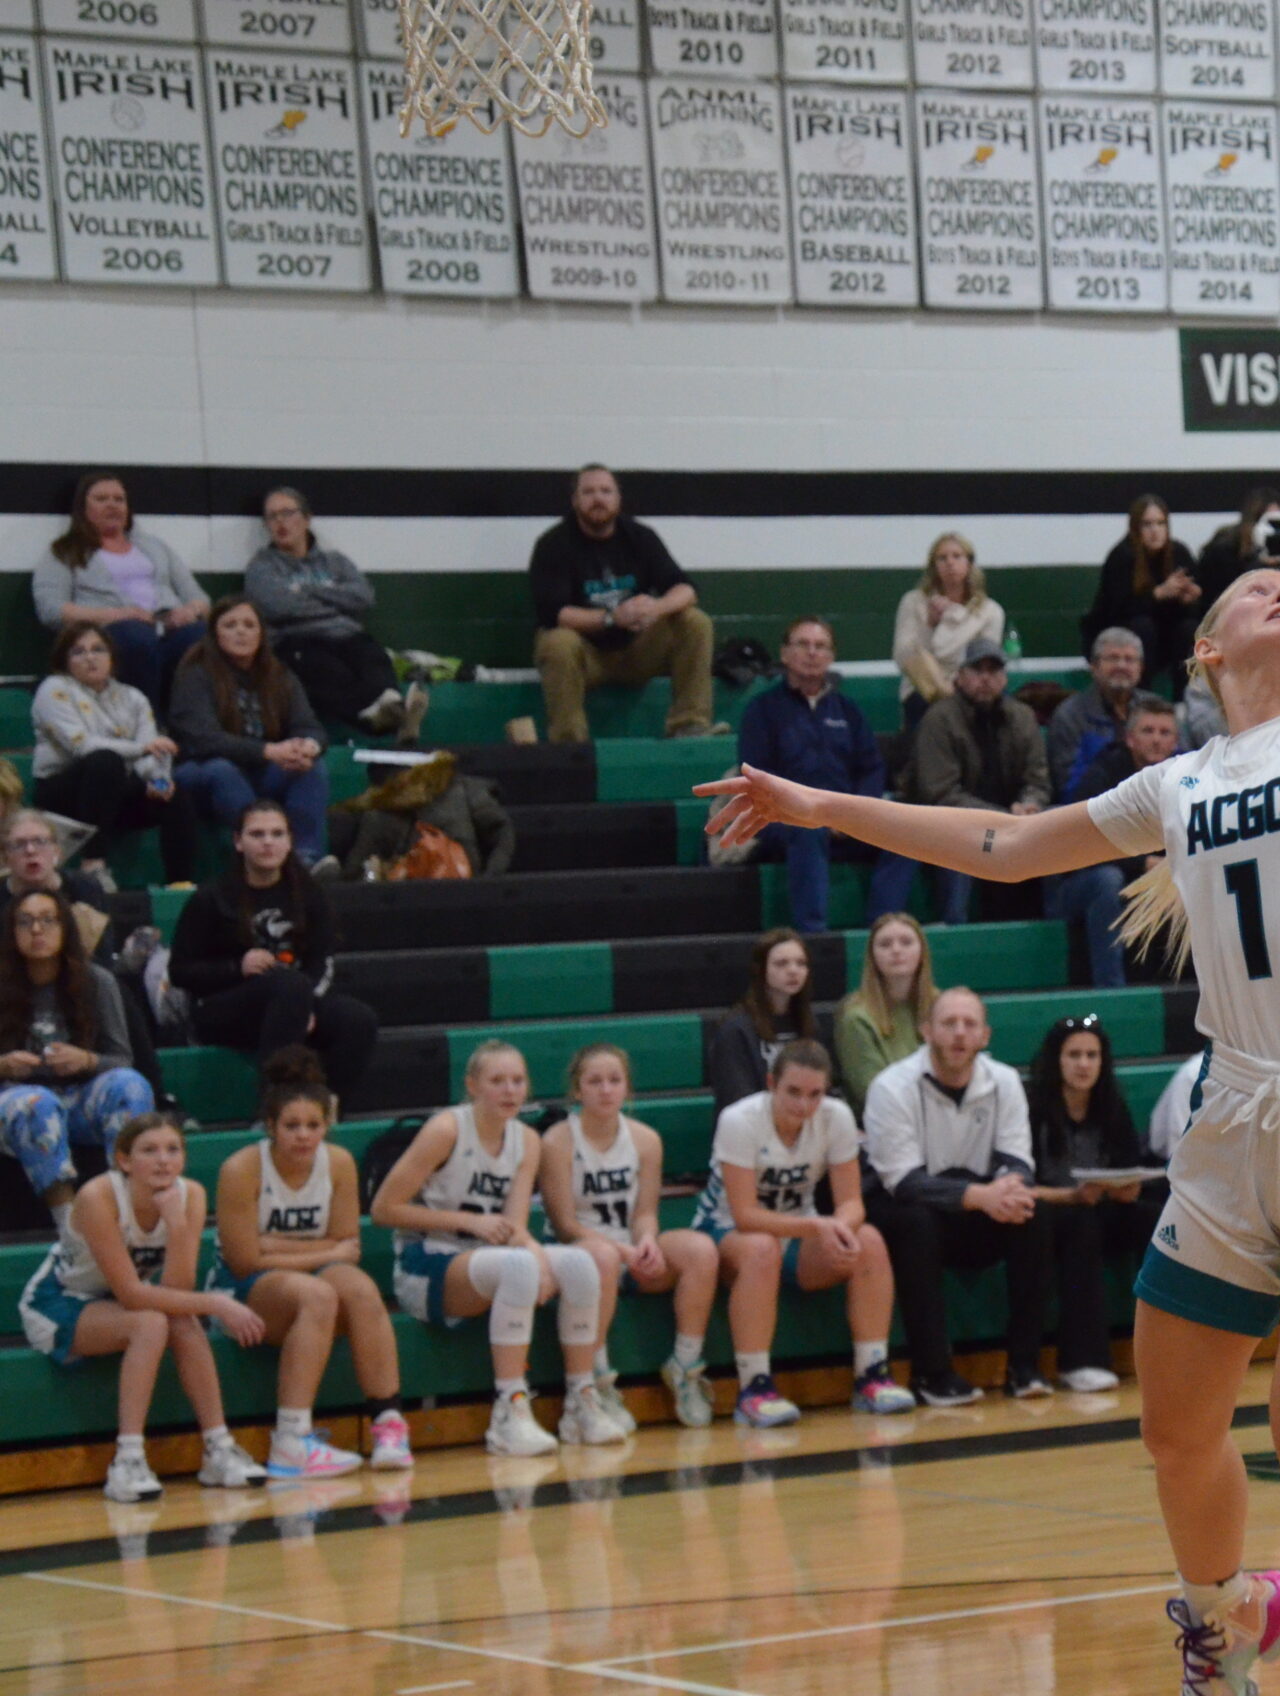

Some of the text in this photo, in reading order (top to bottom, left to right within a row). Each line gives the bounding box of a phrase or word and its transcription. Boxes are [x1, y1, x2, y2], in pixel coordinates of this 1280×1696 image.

[78, 0, 158, 26] 2006
[240, 11, 315, 37] 2007
[681, 8, 719, 31] TRACK
[736, 11, 772, 34] FIELD
[819, 15, 853, 37] TRACK
[1040, 0, 1148, 26] CHAMPIONS
[1165, 1, 1268, 32] CHAMPIONS
[680, 39, 744, 64] 2010
[816, 45, 876, 70] 2011
[1165, 34, 1271, 60] SOFTBALL
[54, 50, 192, 74] MAPLE LAKE
[215, 61, 346, 83] MAPLE LAKE
[948, 52, 1001, 75] 2012
[1069, 59, 1126, 82] 2013
[57, 68, 195, 110] IRISH
[1192, 65, 1245, 87] 2014
[218, 82, 348, 119] IRISH
[792, 96, 900, 117] MAPLE LAKE
[923, 103, 1027, 123] MAPLE LAKE
[658, 102, 773, 133] LIGHTNING
[1045, 105, 1151, 125] MAPLE LAKE
[1168, 110, 1272, 130] MAPLE LAKE
[795, 114, 902, 147] IRISH
[925, 120, 1029, 153] IRISH
[1048, 121, 1152, 154] IRISH
[1170, 127, 1272, 160] IRISH
[62, 136, 202, 173] CONFERENCE
[222, 144, 355, 179] CONFERENCE
[376, 153, 501, 186] CONFERENCE
[522, 161, 644, 194] CONFERENCE
[660, 167, 778, 198] CONFERENCE
[66, 170, 206, 208] CHAMPIONS
[225, 180, 357, 217] CHAMPIONS
[798, 172, 906, 203] CONFERENCE
[926, 177, 1032, 208] CONFERENCE
[1051, 180, 1156, 210] CONFERENCE
[1171, 185, 1275, 214] CONFERENCE
[379, 188, 505, 224] CHAMPIONS
[525, 196, 647, 230] CHAMPIONS
[664, 201, 779, 234] CHAMPIONS
[68, 212, 209, 240] VOLLEYBALL
[269, 221, 313, 245] TRACK
[326, 225, 363, 247] FIELD
[800, 206, 908, 238] CHAMPIONS
[928, 210, 1035, 241] CHAMPIONS
[1052, 213, 1159, 244] CHAMPIONS
[1173, 217, 1277, 247] CHAMPIONS
[418, 229, 459, 250] TRACK
[474, 231, 509, 253] FIELD
[528, 237, 650, 258] WRESTLING
[667, 241, 786, 261] WRESTLING
[801, 240, 911, 266] BASEBALL
[104, 248, 183, 272] 2006
[258, 254, 331, 277] 2007
[407, 260, 480, 283] 2008
[551, 266, 637, 288] 2009-10
[686, 270, 769, 290] 2010-11
[830, 272, 886, 293] 2012
[957, 275, 1011, 296] 2012
[1077, 277, 1140, 300] 2013
[1200, 280, 1253, 302] 2014
[1223, 858, 1273, 980] 1
[583, 1167, 631, 1195] ACGC
[267, 1206, 321, 1232] ACGC
[592, 1200, 628, 1228] 11
